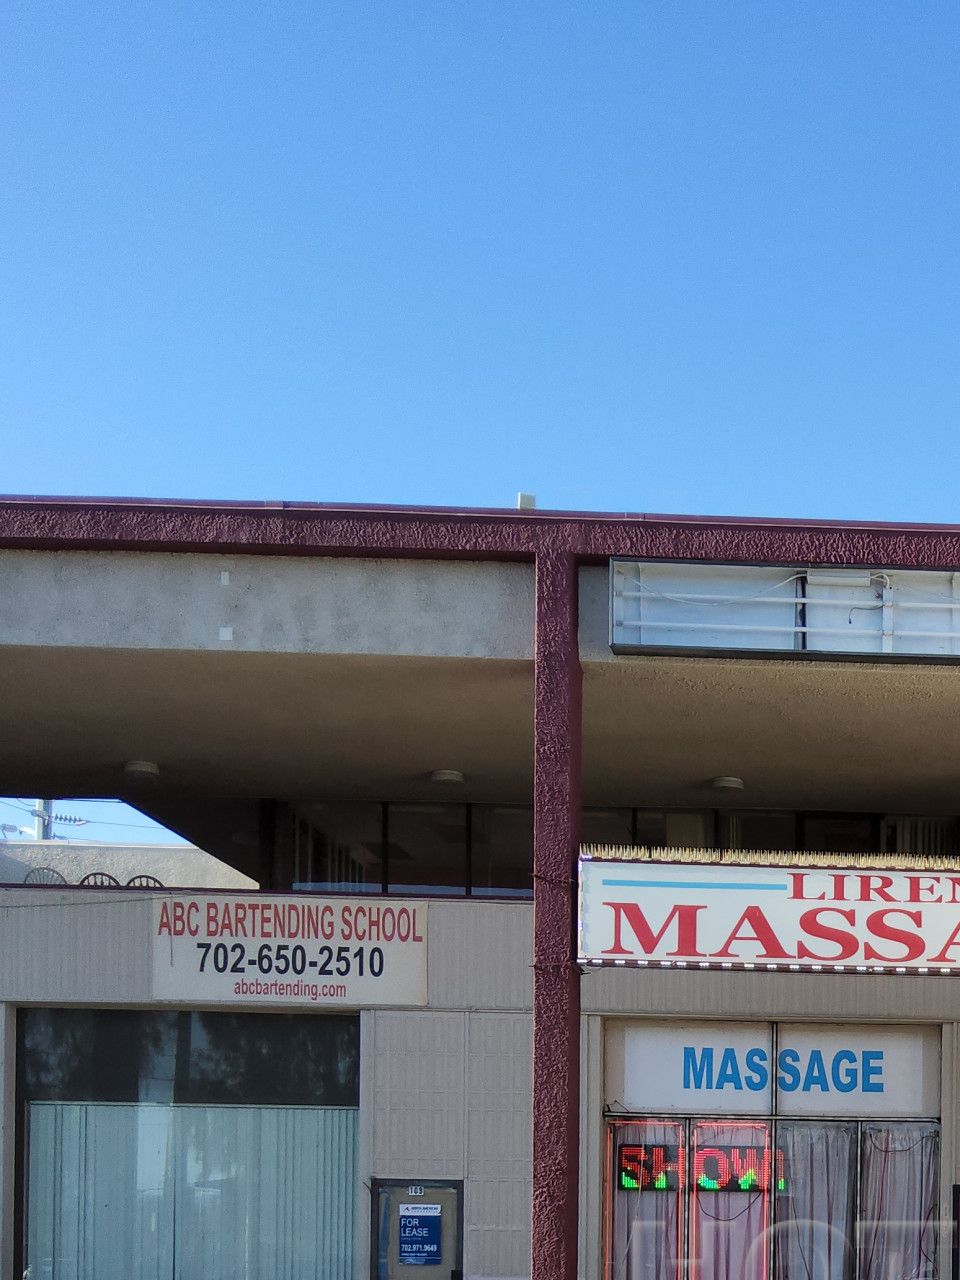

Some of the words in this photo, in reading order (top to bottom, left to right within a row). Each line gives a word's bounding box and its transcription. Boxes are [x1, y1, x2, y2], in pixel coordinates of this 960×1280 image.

[158, 901, 199, 937] ABC
[206, 902, 335, 940] BARTENDING
[340, 905, 423, 942] SCHOOL
[196, 942, 384, 977] 702-650-2510
[234, 979, 347, 1000] abcbartending.com
[682, 1046, 885, 1093] MASSAGE
[401, 1218, 419, 1227] FOR
[401, 1227, 429, 1237] LEASE
